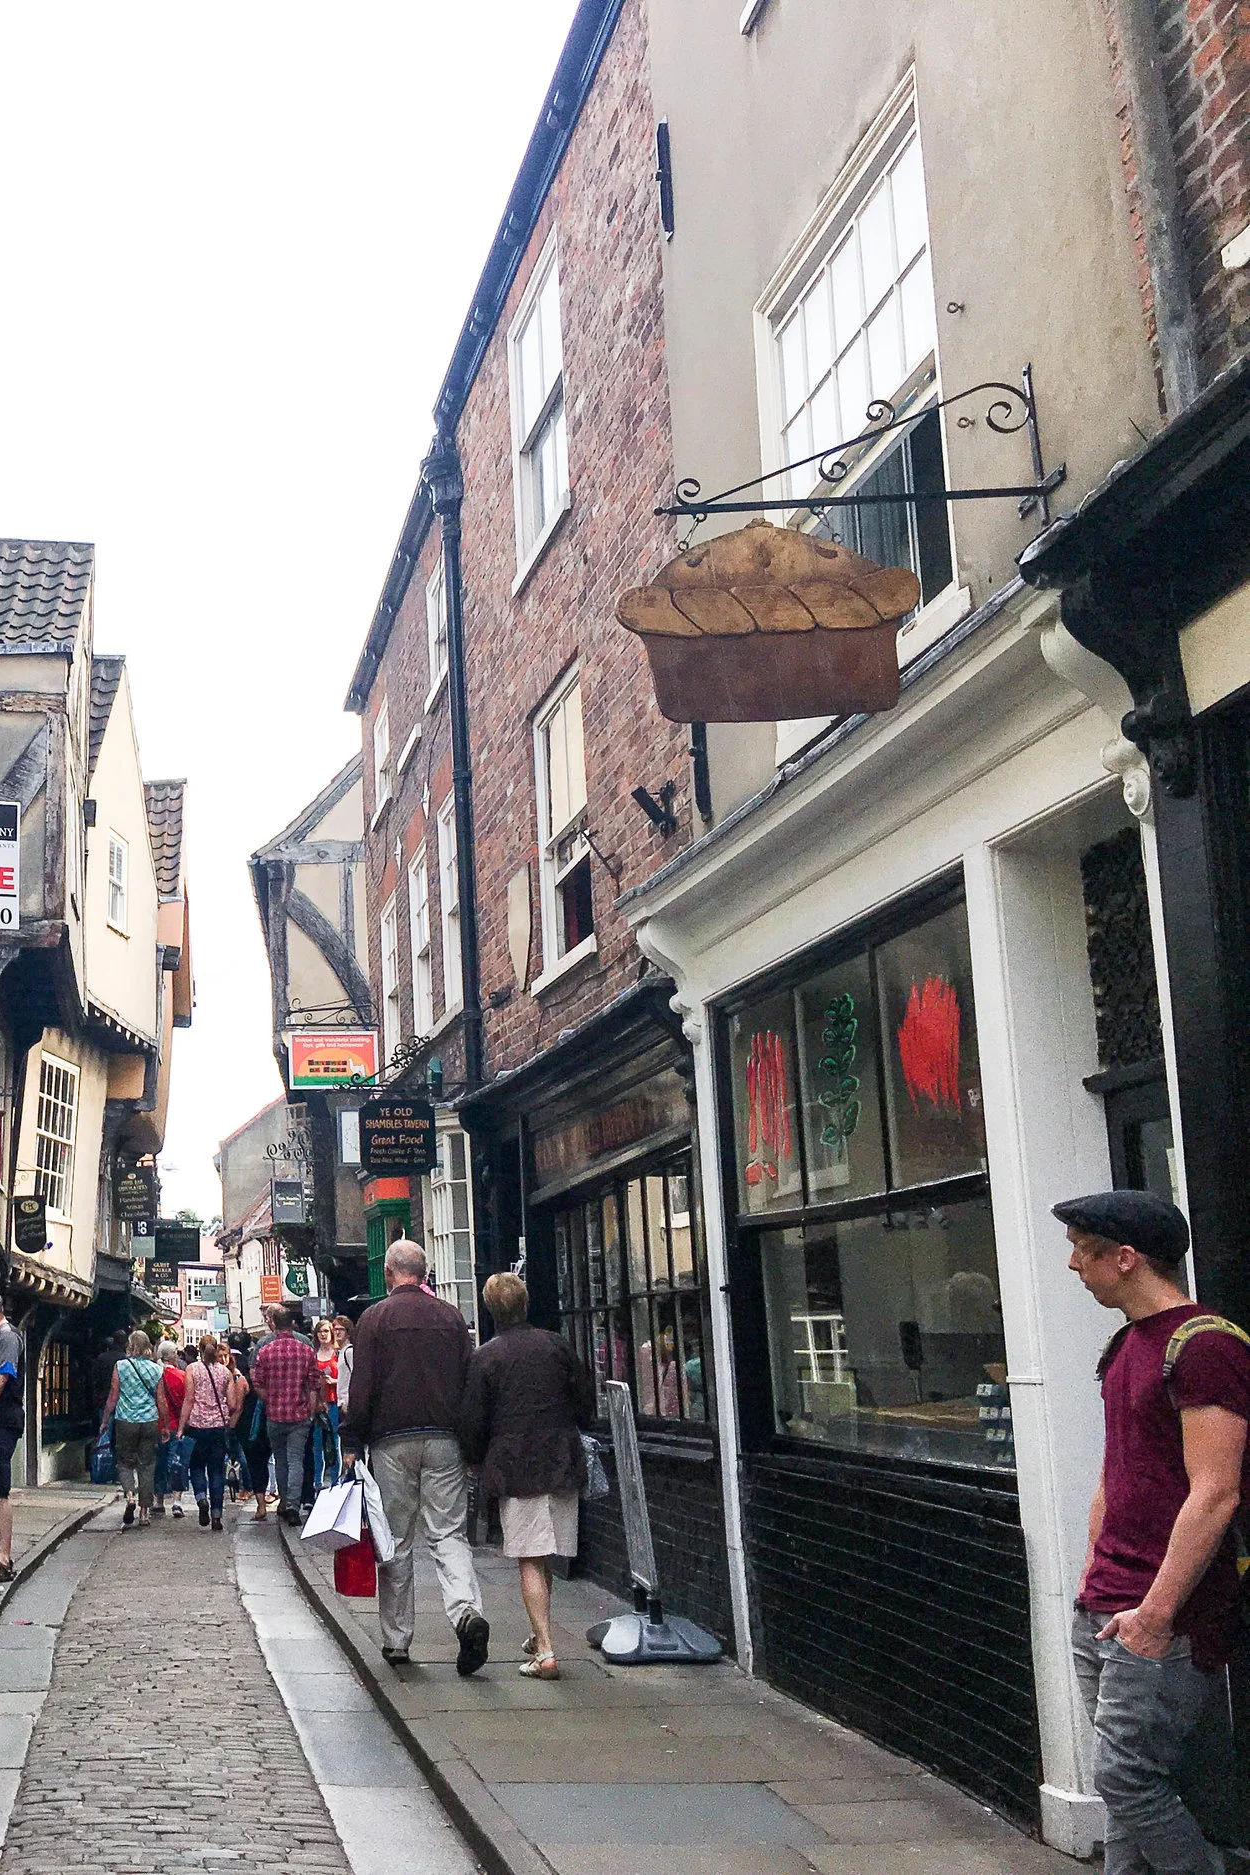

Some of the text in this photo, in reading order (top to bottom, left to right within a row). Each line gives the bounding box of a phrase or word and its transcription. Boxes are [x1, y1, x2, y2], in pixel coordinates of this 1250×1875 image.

[379, 1107, 413, 1117] YE OLD
[365, 1119, 430, 1129] SHAMBLES TAVERN
[371, 1134, 424, 1145] Great Food
